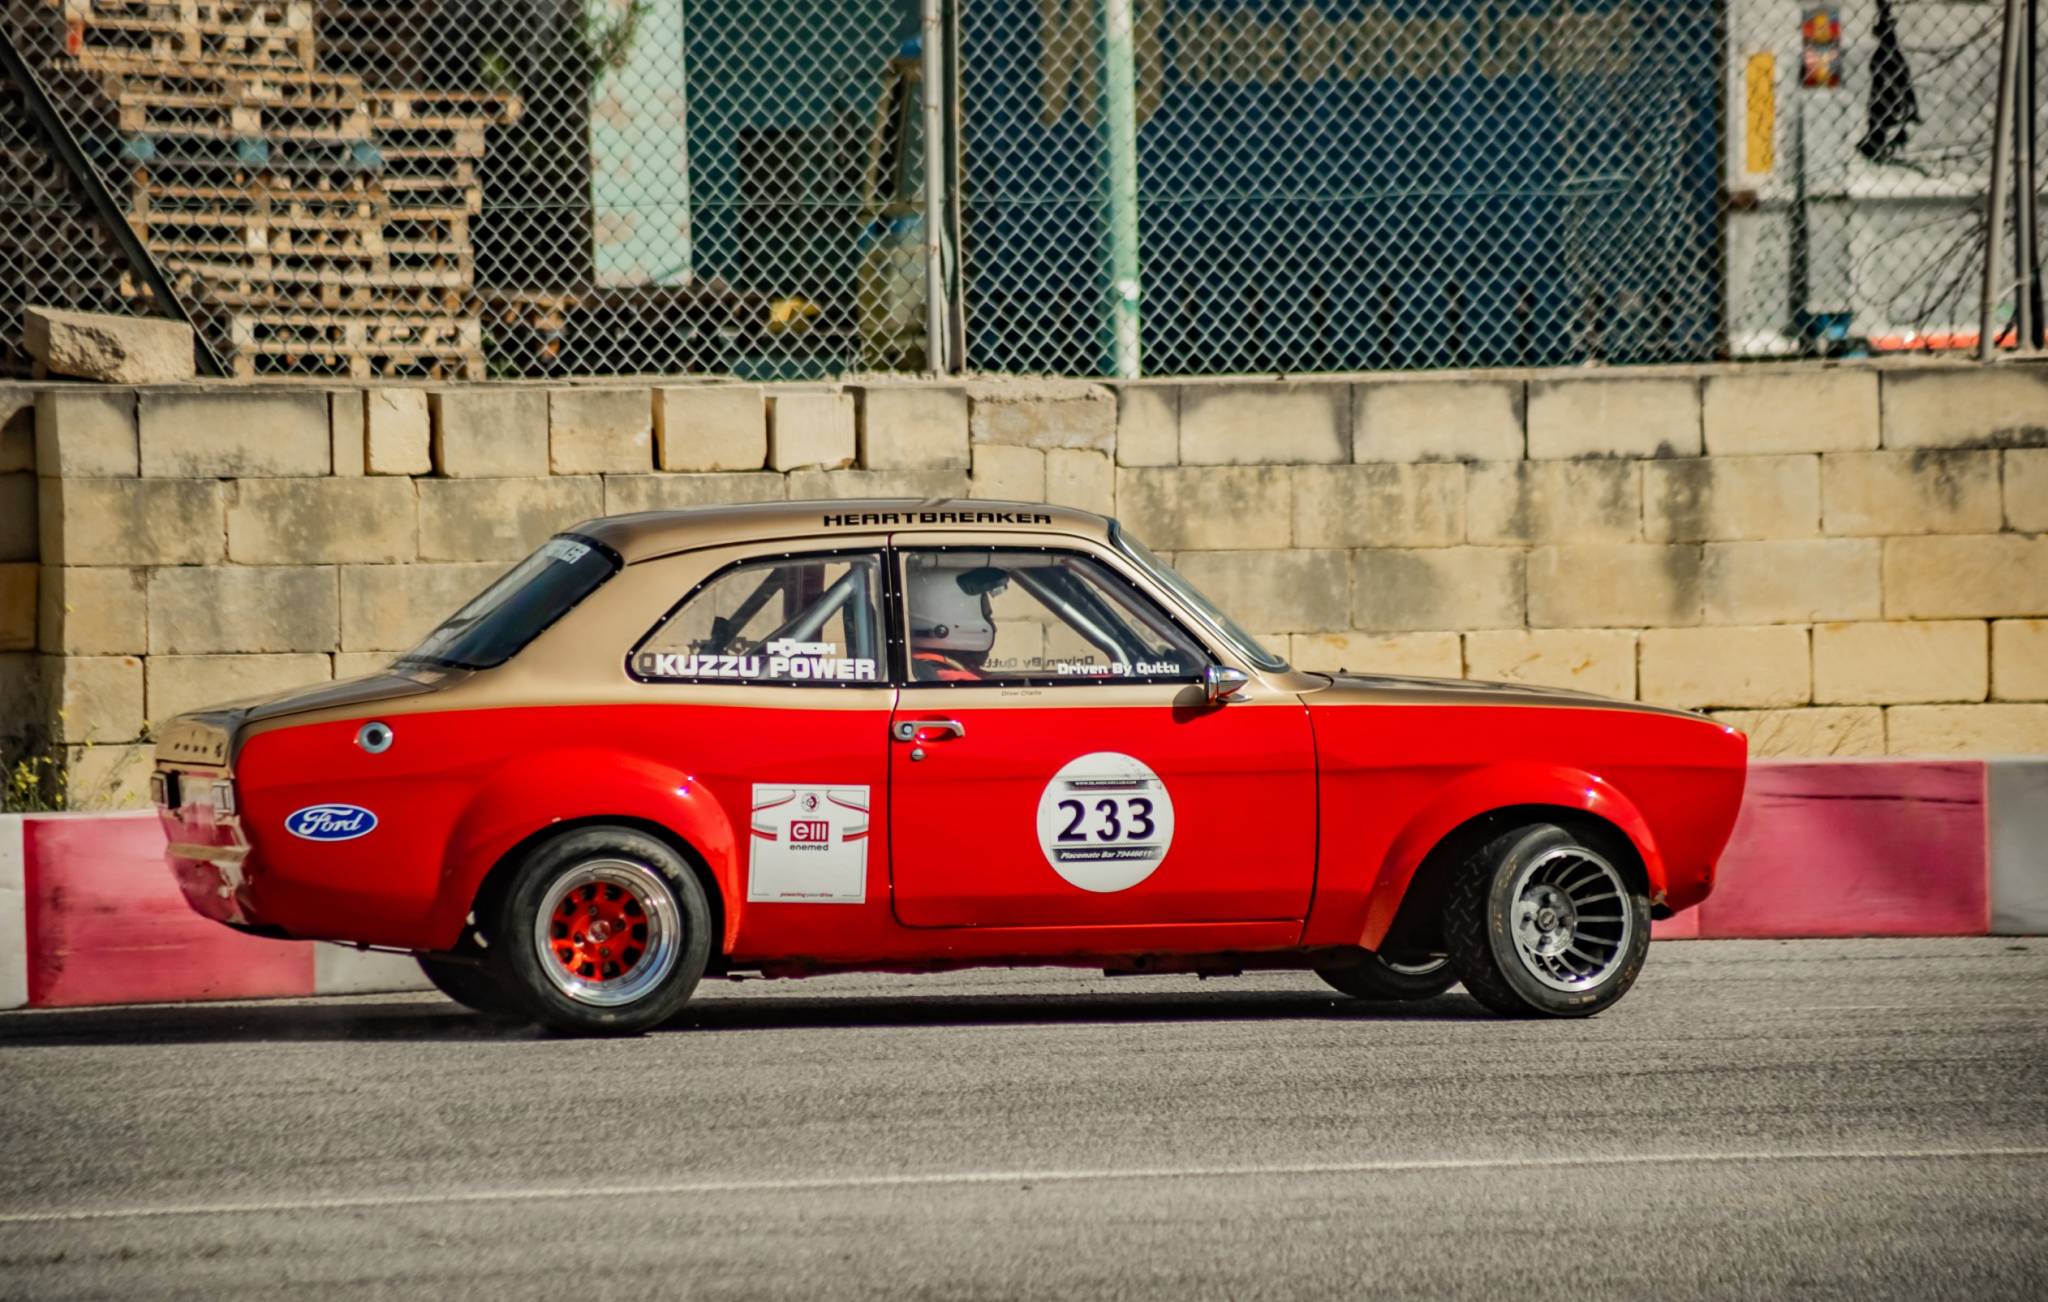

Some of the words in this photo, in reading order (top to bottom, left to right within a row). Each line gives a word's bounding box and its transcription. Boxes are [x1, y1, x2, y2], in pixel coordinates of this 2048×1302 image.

[823, 511, 1052, 527] HEARTBREAKER
[655, 653, 760, 678] KUZZU
[769, 657, 876, 681] POWER
[1057, 662, 1109, 675] Driven
[1112, 661, 1133, 677] By
[1136, 661, 1180, 675] Quttu
[298, 808, 364, 835] Ford
[1057, 797, 1156, 842] 233
